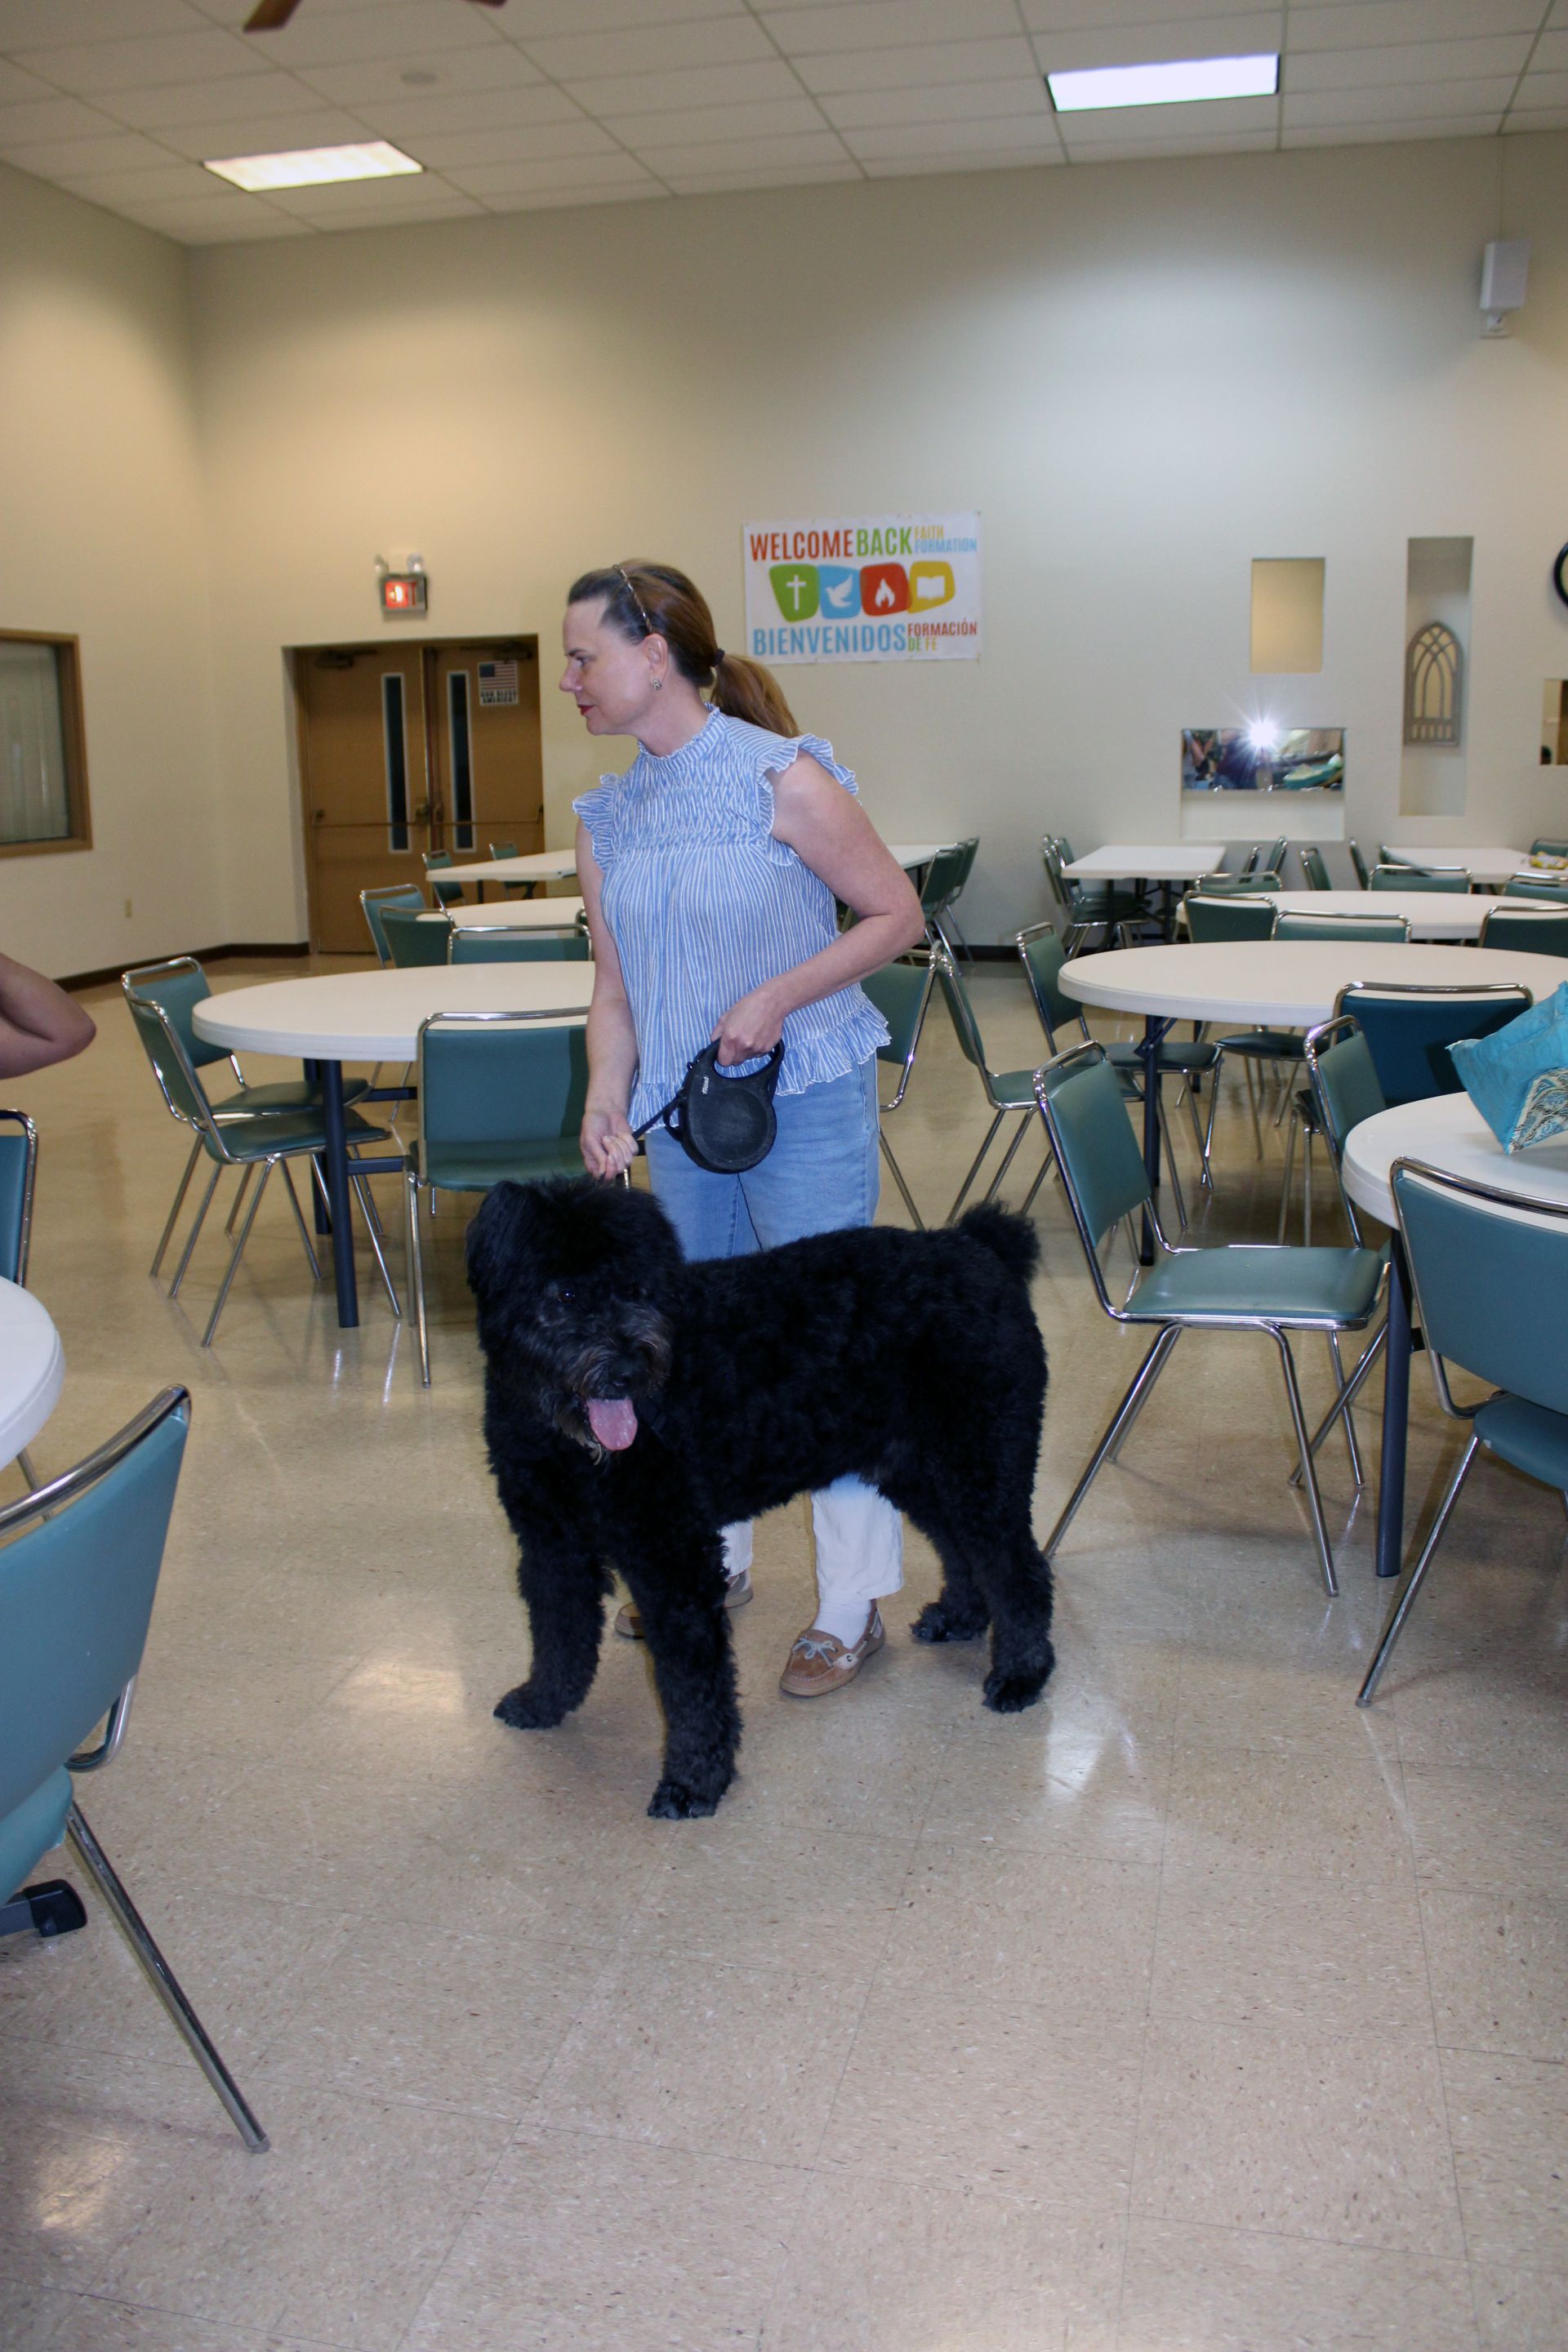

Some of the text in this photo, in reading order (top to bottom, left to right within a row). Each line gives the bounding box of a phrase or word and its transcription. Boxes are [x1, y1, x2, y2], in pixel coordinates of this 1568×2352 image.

[914, 525, 944, 539] FAITH
[750, 526, 912, 561] WELCOME BACK
[914, 537, 978, 554] FORMATION
[907, 617, 978, 636] FORMACIÓN
[753, 623, 906, 656] BIENVENIDOS
[907, 637, 922, 652] DE
